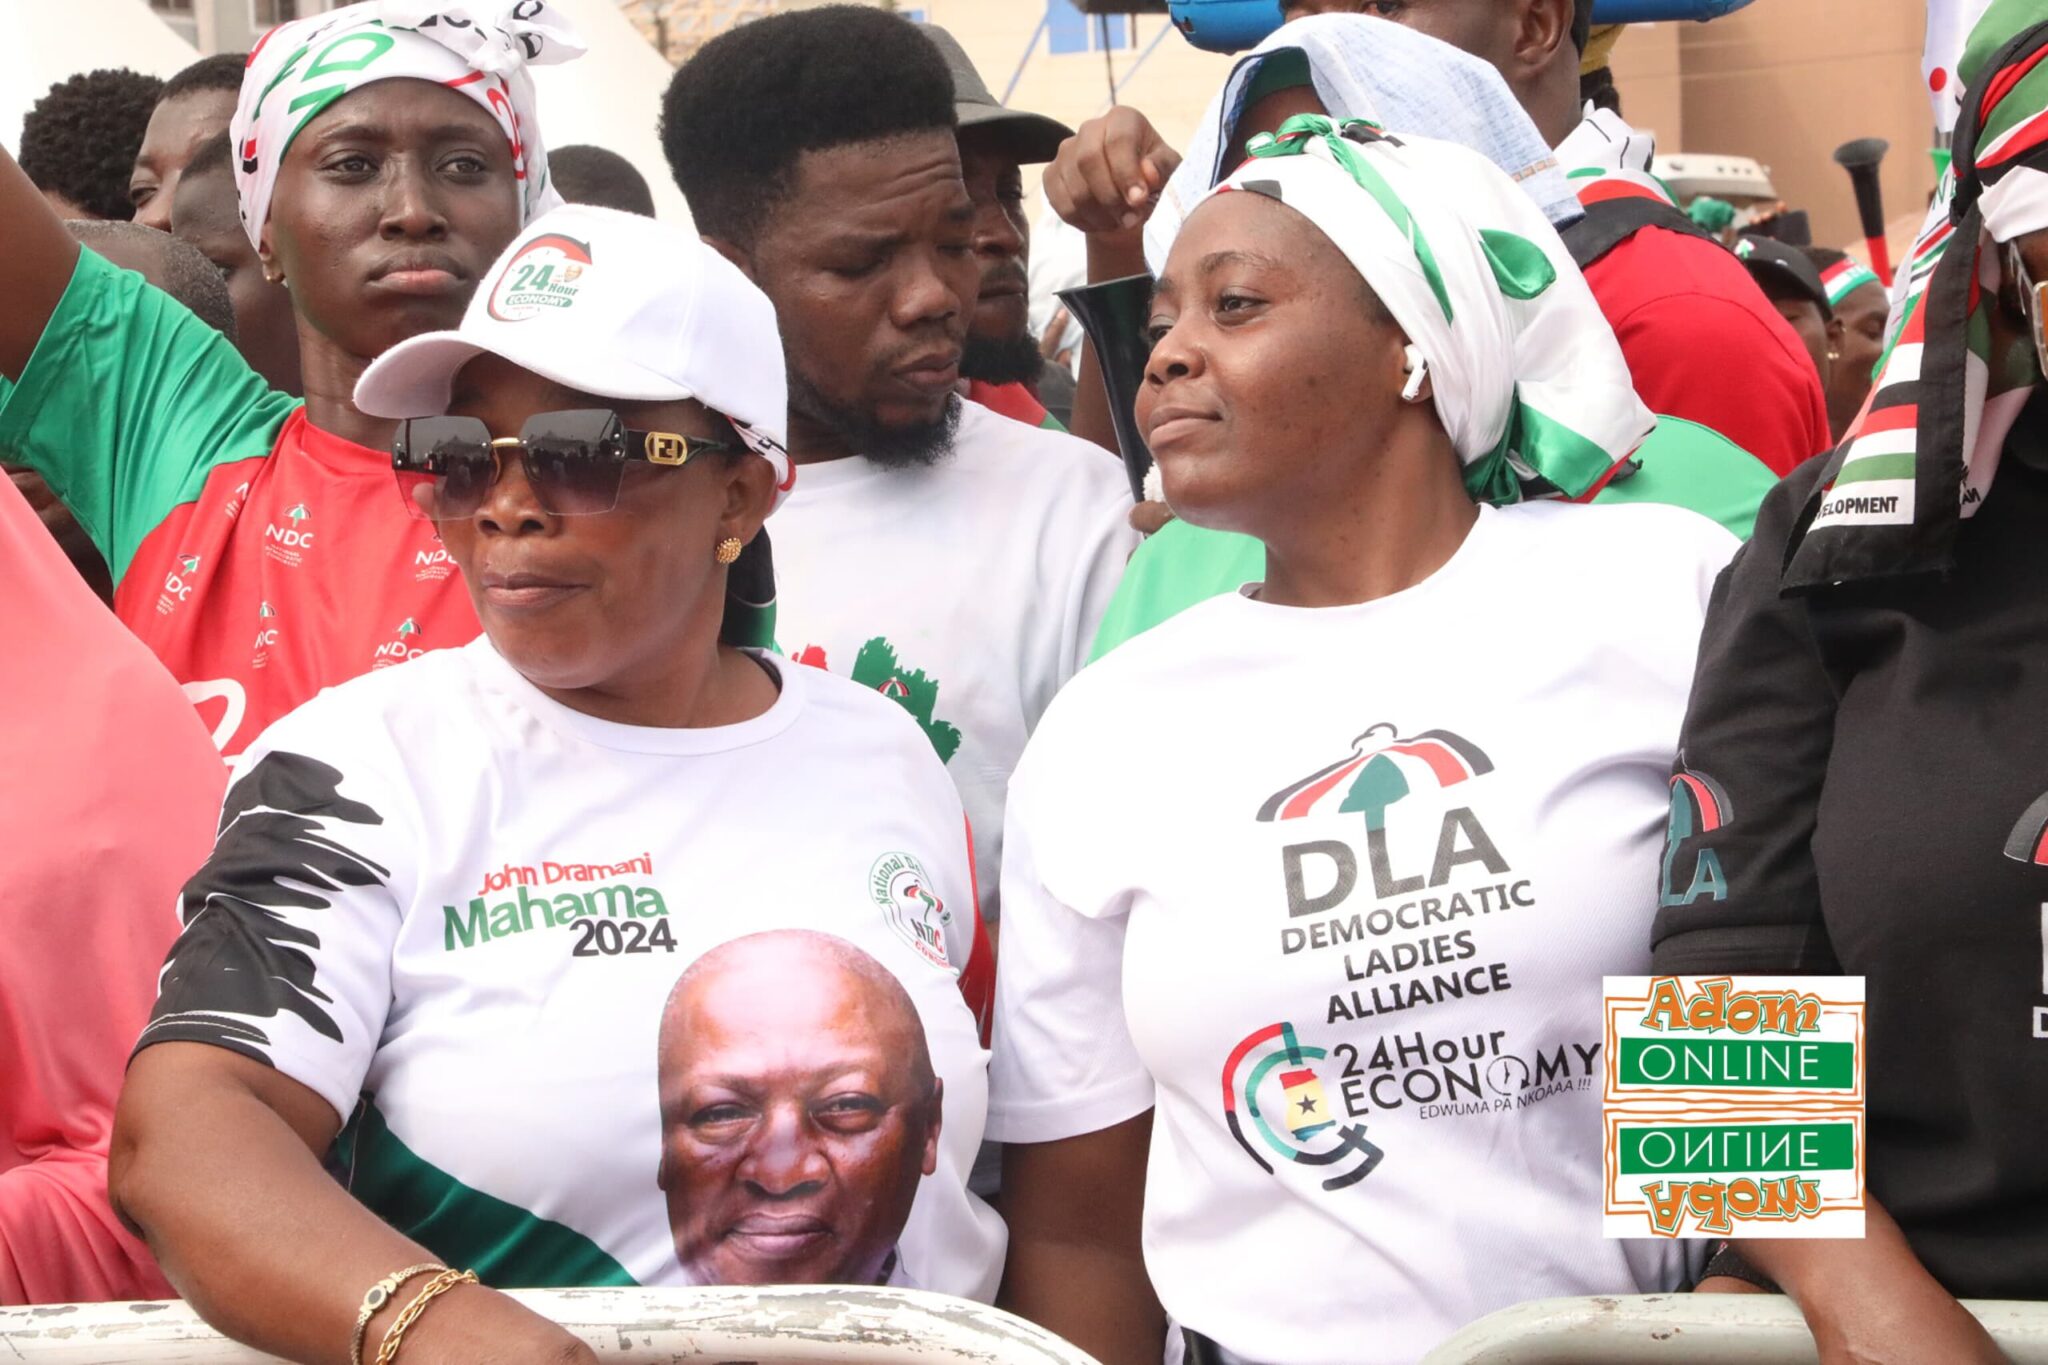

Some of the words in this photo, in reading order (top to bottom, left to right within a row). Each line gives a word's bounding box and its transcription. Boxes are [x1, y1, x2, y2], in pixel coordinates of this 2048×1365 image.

[510, 264, 555, 291] 24
[548, 283, 579, 296] Hour
[509, 293, 570, 307] ECONOMY
[265, 523, 314, 549] NDC
[477, 864, 538, 896] John
[543, 852, 652, 884] Dramani
[1282, 806, 1511, 918] DLA
[443, 884, 670, 951] Mahama
[569, 918, 678, 957] 2024
[1281, 880, 1536, 954] DEMOCRATIC
[1344, 930, 1476, 981] LADIES
[1327, 963, 1512, 1024] ALLIANCE
[1420, 1099, 1490, 1120] EDWUMA
